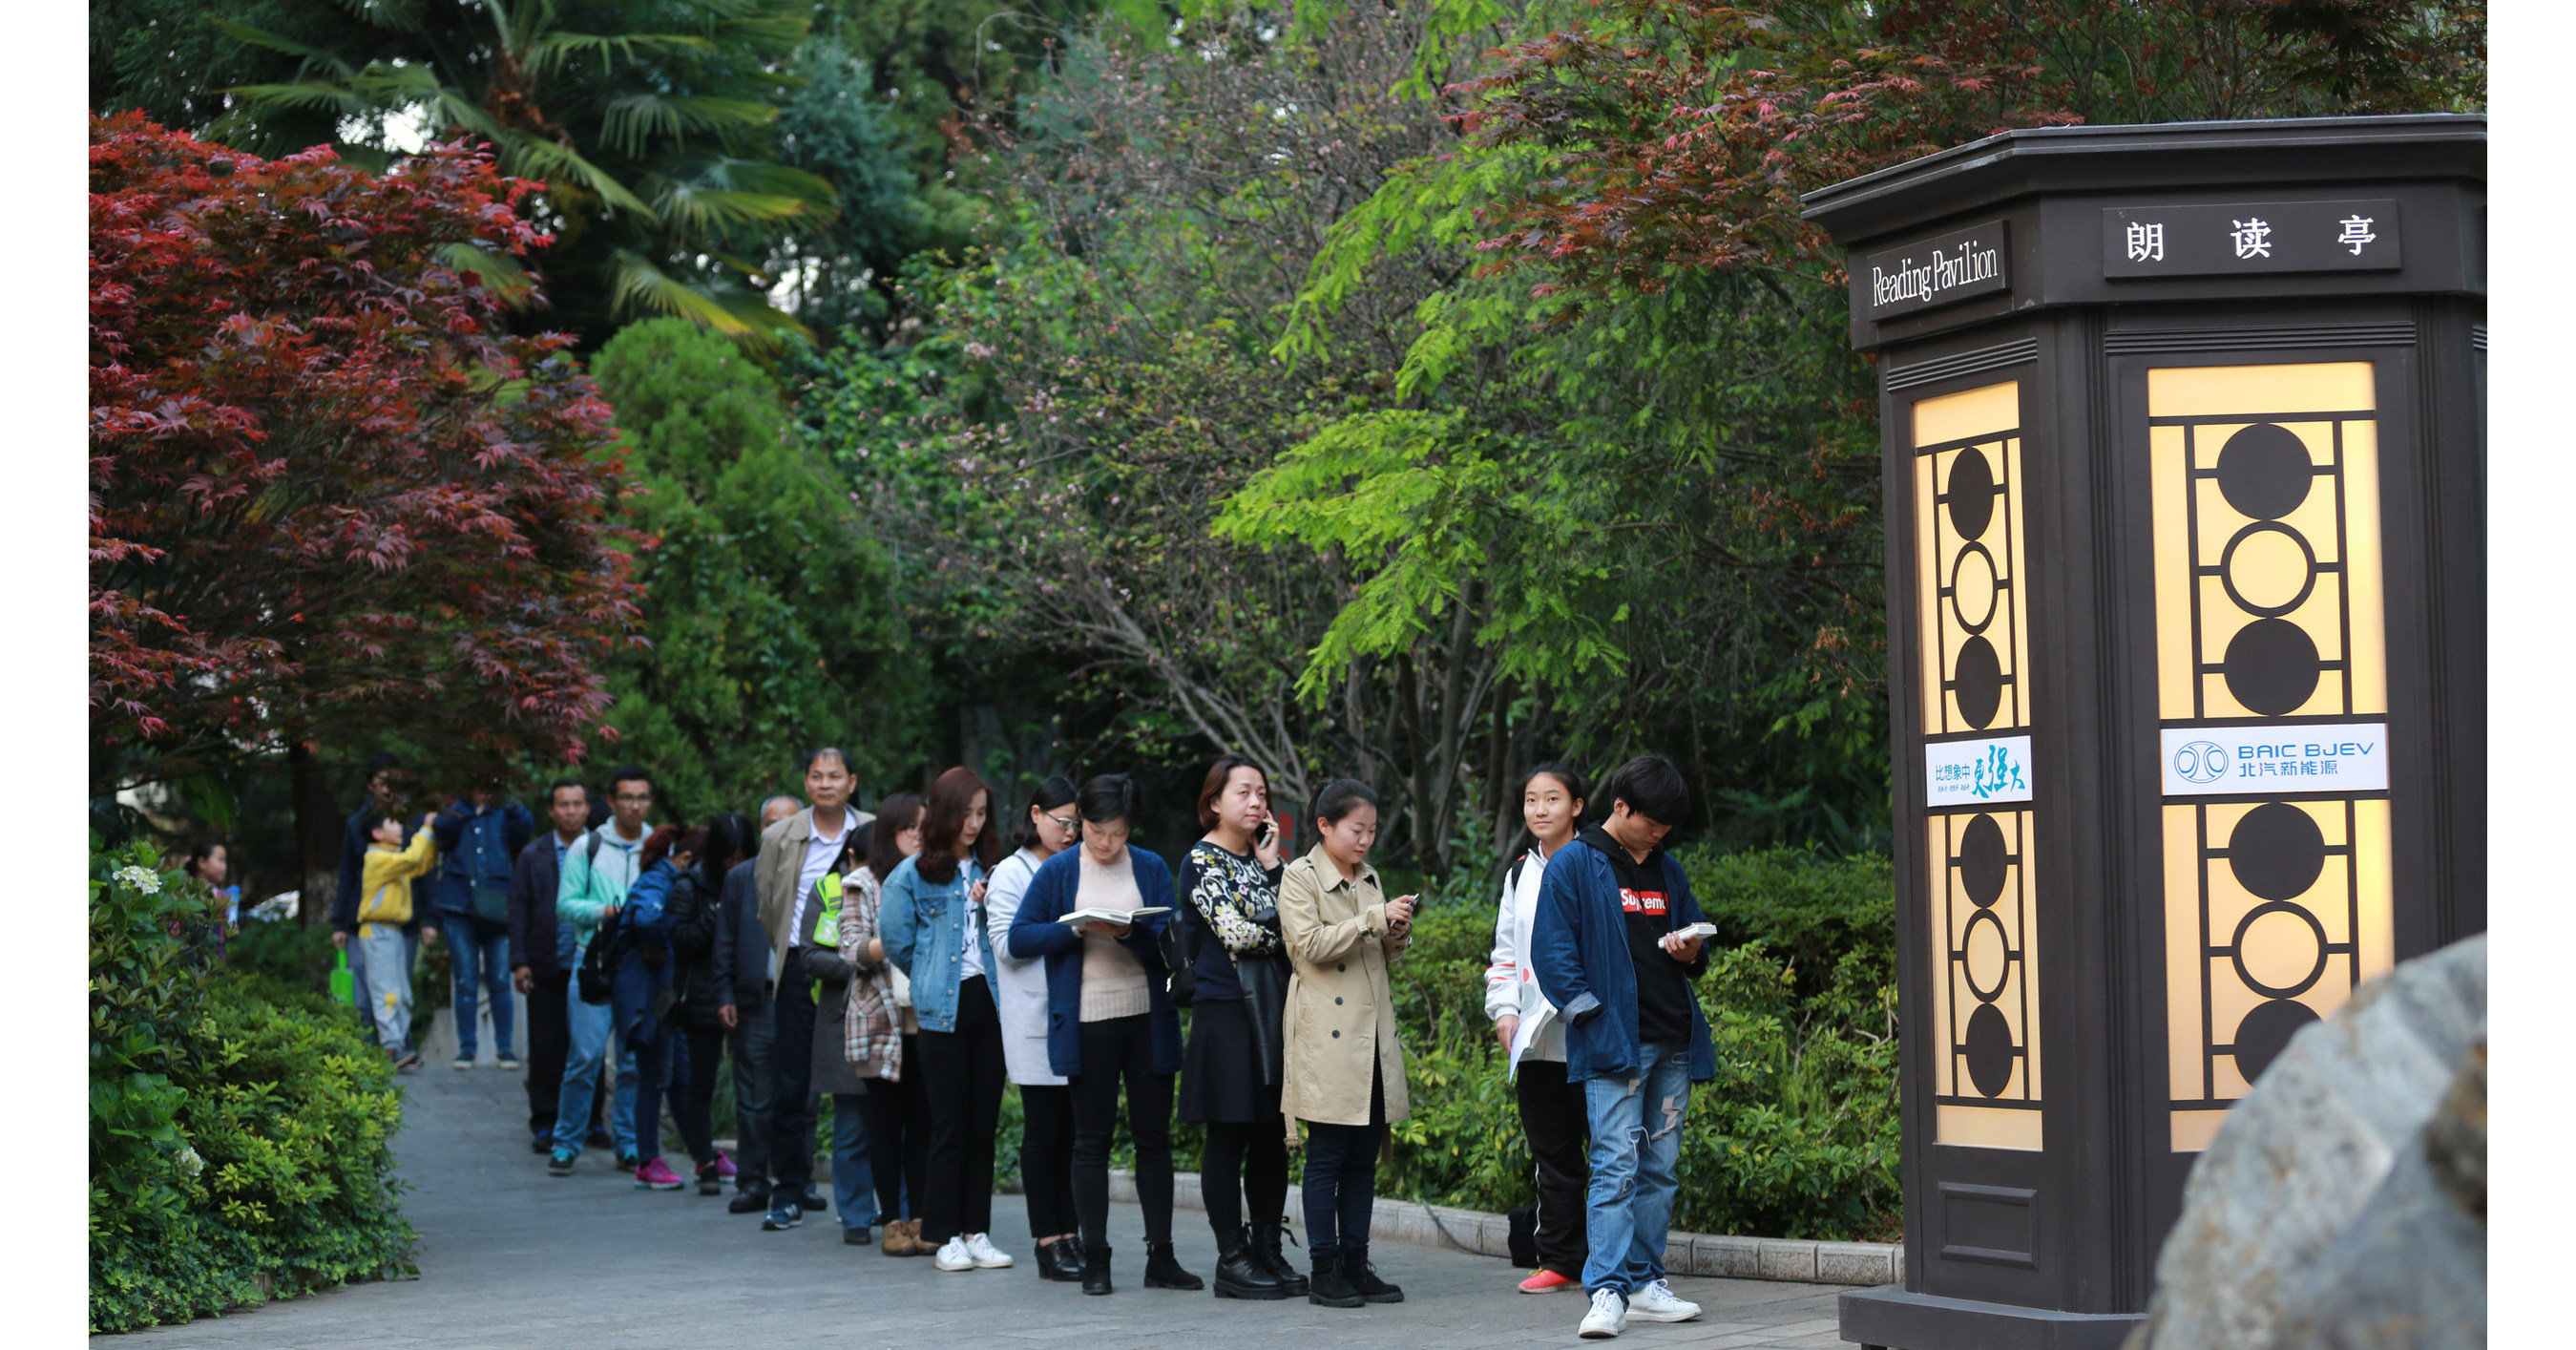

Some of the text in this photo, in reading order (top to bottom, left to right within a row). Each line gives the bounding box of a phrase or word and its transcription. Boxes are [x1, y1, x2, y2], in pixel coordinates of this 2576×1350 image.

[2126, 214, 2377, 263] 朗读亭
[1873, 240, 1998, 306] Reading Pavilion
[2238, 742, 2375, 759] BAIC BJEV
[2238, 760, 2338, 777] 北汽新能源
